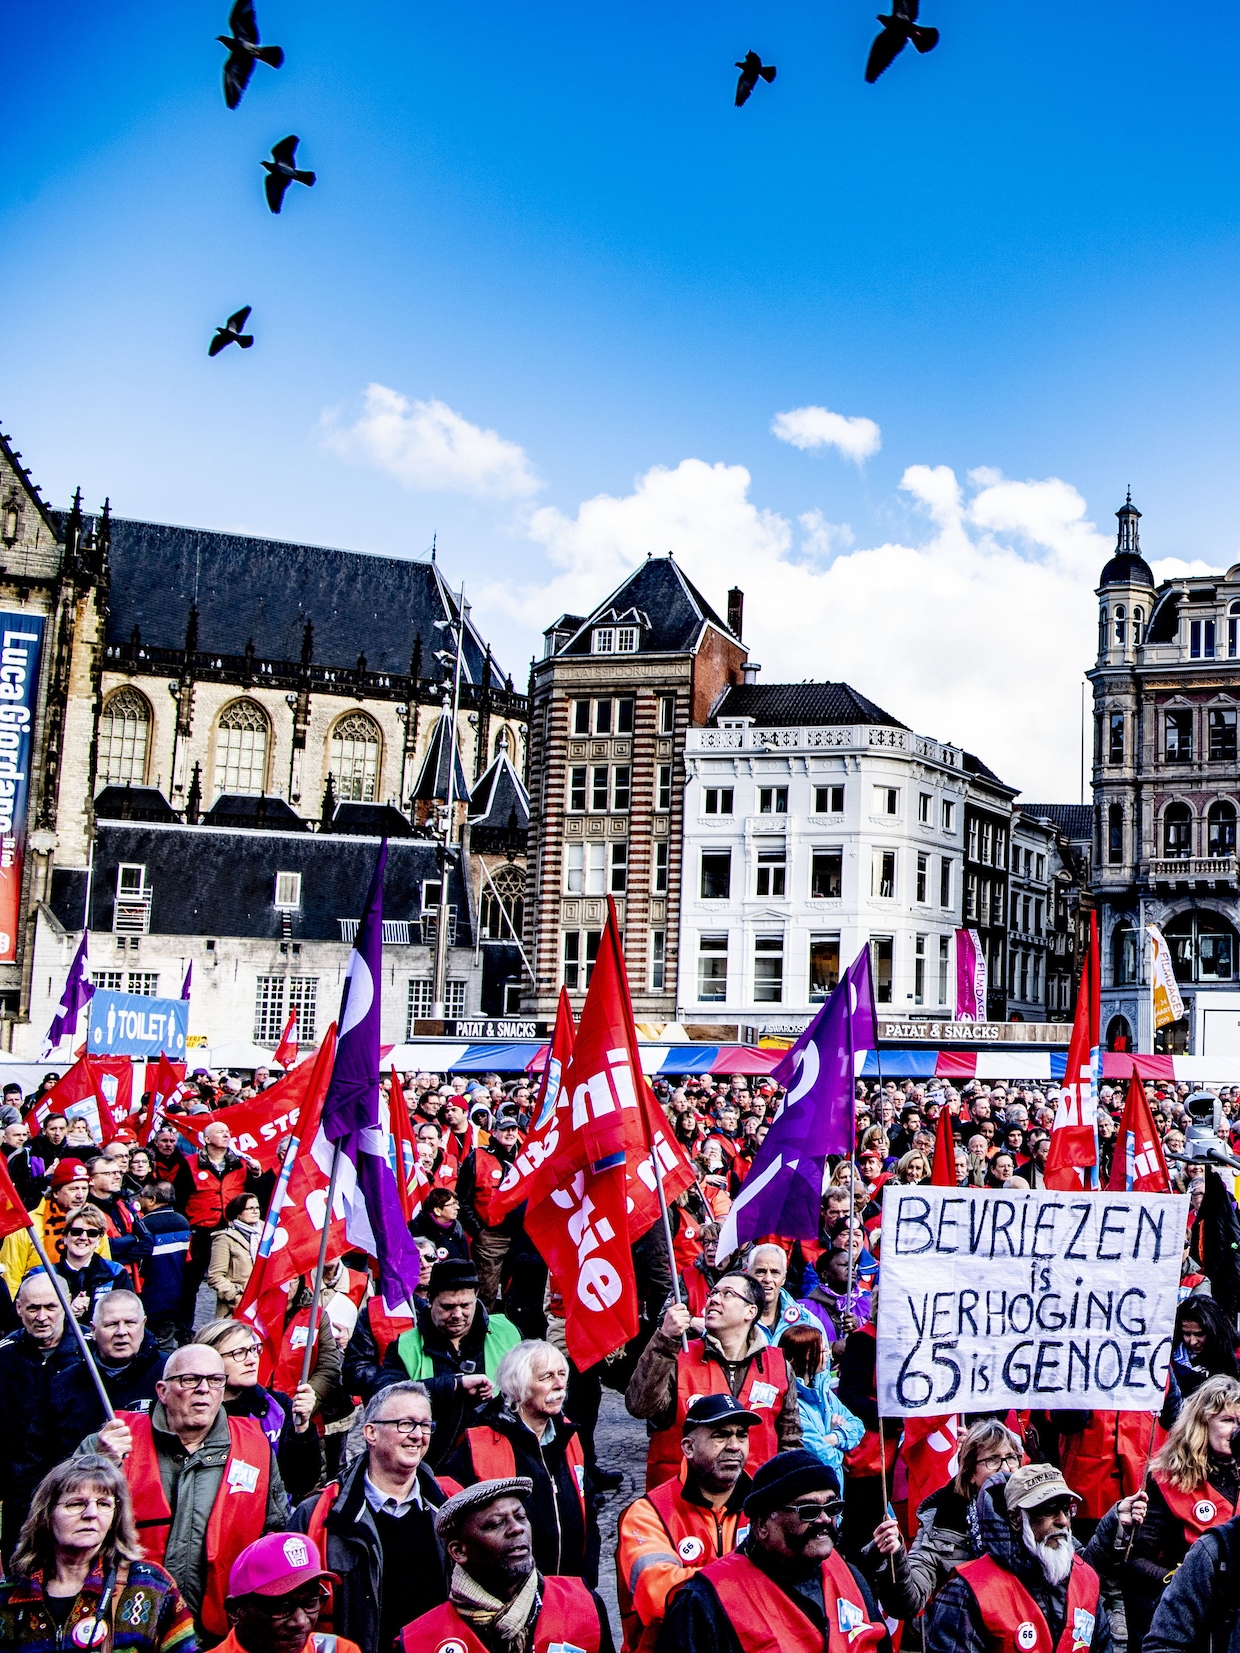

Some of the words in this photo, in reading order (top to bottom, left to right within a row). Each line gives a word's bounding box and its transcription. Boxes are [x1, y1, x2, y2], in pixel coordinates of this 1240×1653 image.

[0, 630, 37, 700] Luca
[1156, 1006, 1171, 1016] AART
[118, 1010, 167, 1041] TOILET
[456, 1022, 485, 1037] PATAT
[486, 1022, 494, 1037] &
[497, 1022, 537, 1037] SNACKS
[885, 1025, 927, 1037] PATAT
[930, 1024, 940, 1037] &
[945, 1027, 999, 1039] SNACKS
[895, 1193, 1165, 1263] BEVRIEZEN
[1030, 1260, 1051, 1293] is
[907, 1276, 1148, 1339] VERHOGING
[896, 1338, 962, 1409] 65
[970, 1353, 990, 1393] is
[231, 1463, 259, 1485] FNV
[1199, 1505, 1210, 1514] 66
[682, 1543, 694, 1555] 66
[1022, 1630, 1033, 1639] 66
